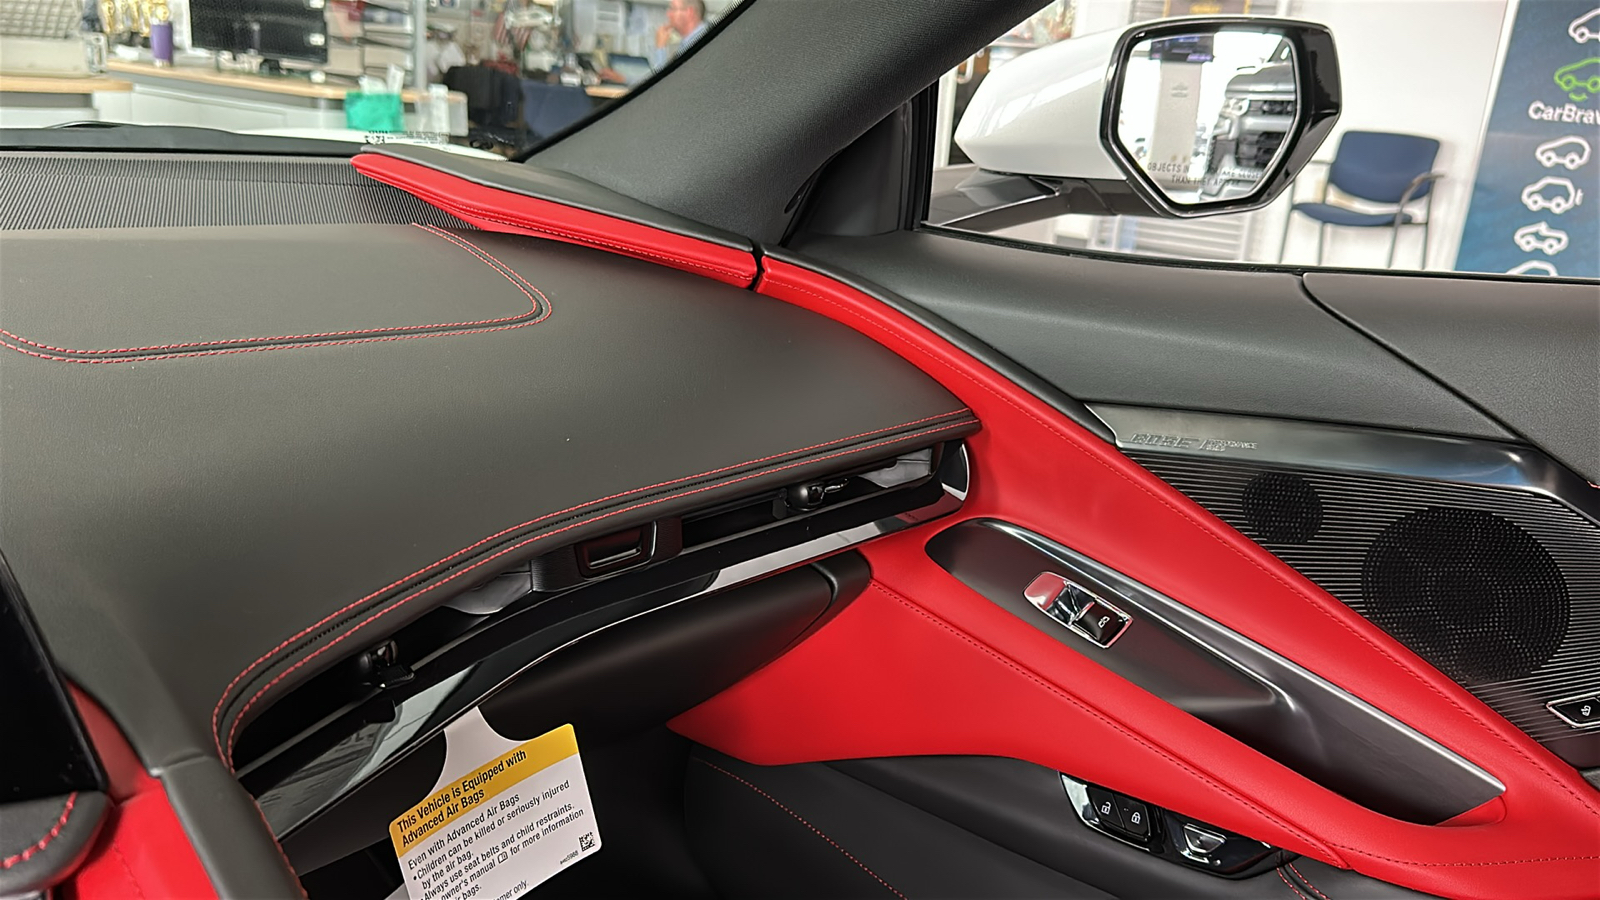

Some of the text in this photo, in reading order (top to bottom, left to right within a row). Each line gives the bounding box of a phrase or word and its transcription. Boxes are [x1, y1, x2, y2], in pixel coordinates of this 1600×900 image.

[1147, 162, 1182, 173] OBJECTS
[1171, 175, 1190, 185] THAN
[397, 750, 526, 833] This Vehicle is Equipped with
[402, 789, 484, 848] Advanced Air Bags
[448, 843, 462, 858] can
[463, 836, 474, 847] be
[474, 821, 496, 840] killed
[497, 817, 505, 827] or
[507, 796, 540, 820] seriously
[542, 780, 570, 800] injured
[408, 794, 520, 870] Even with Advanced Air Bags
[424, 803, 574, 900] Always use seat belts and child restraints.
[441, 809, 584, 900] owner's manual for more information
[422, 850, 474, 890] by the air bag.
[462, 884, 482, 900] bags.
